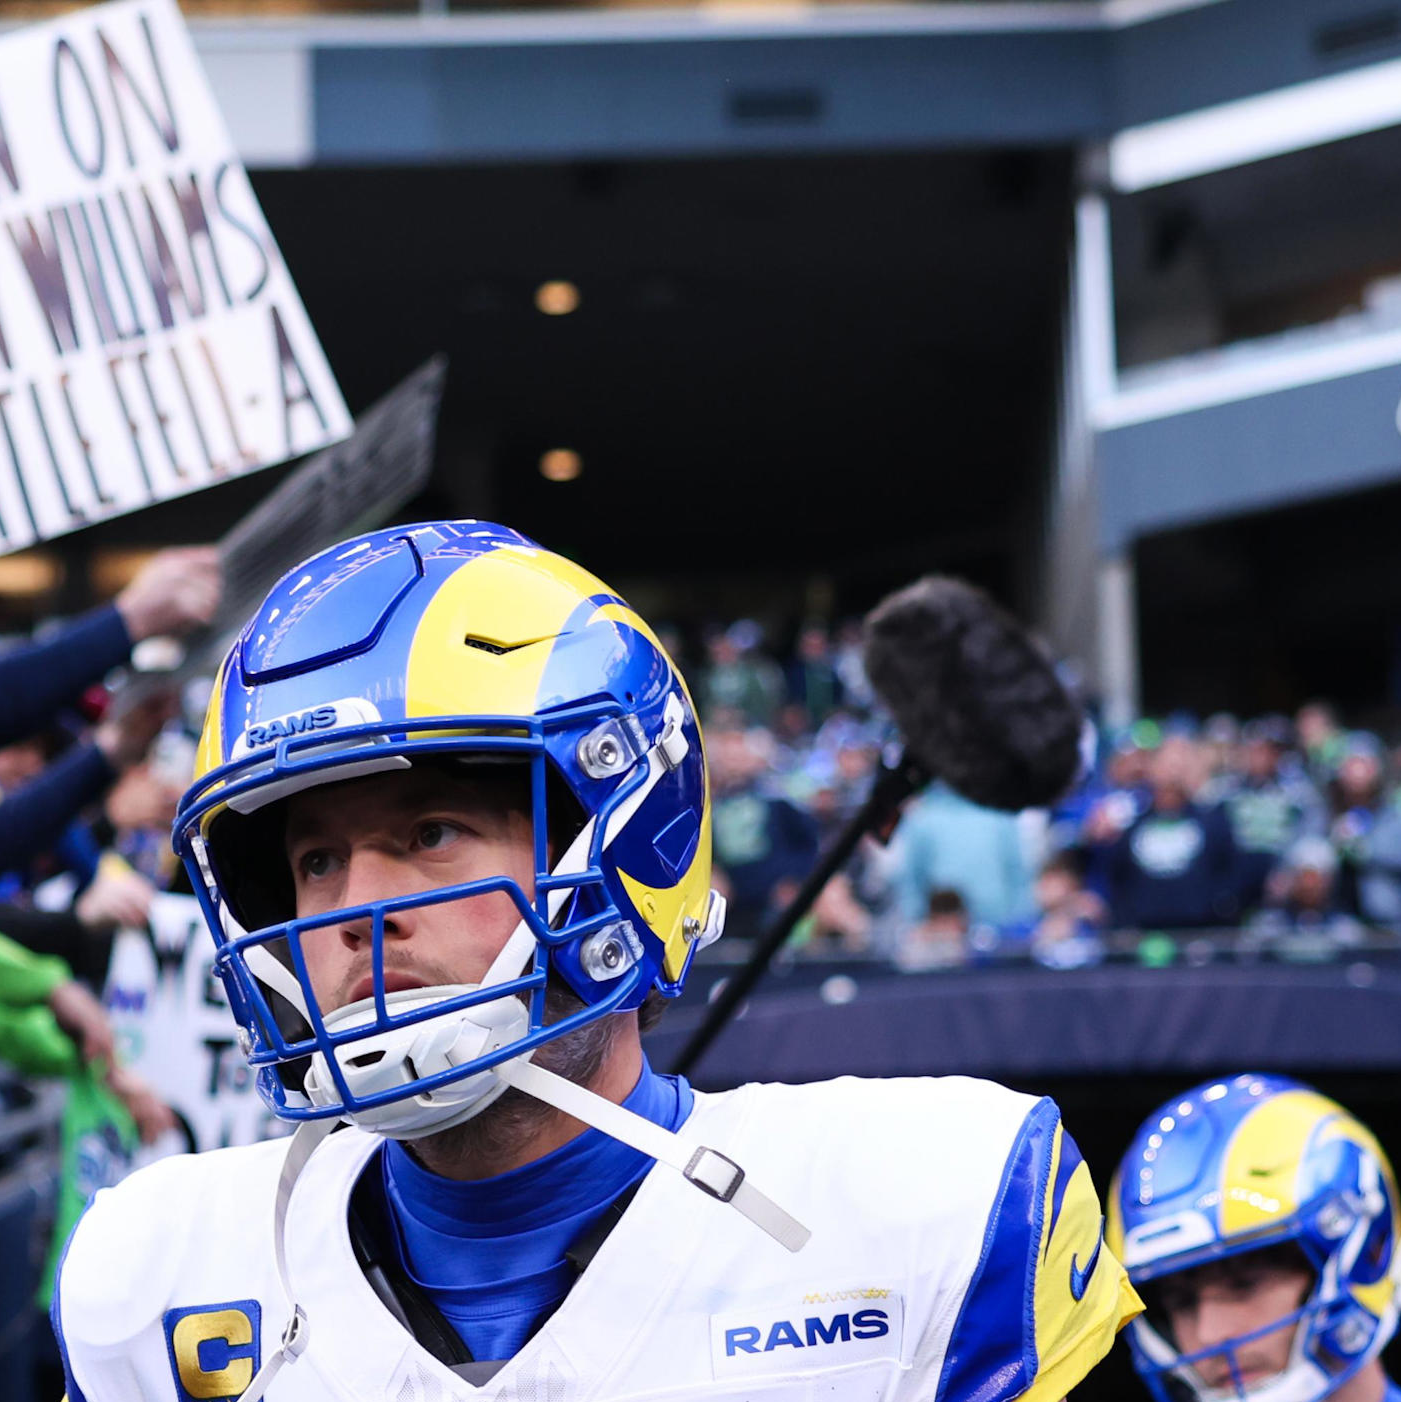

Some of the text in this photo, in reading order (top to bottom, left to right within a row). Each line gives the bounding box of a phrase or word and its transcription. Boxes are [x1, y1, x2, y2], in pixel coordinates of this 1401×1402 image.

[53, 14, 180, 179] ON
[5, 162, 269, 356] WILLIAMS
[245, 705, 337, 749] RAMS
[172, 1309, 254, 1399] C
[725, 1309, 890, 1357] RAMS
